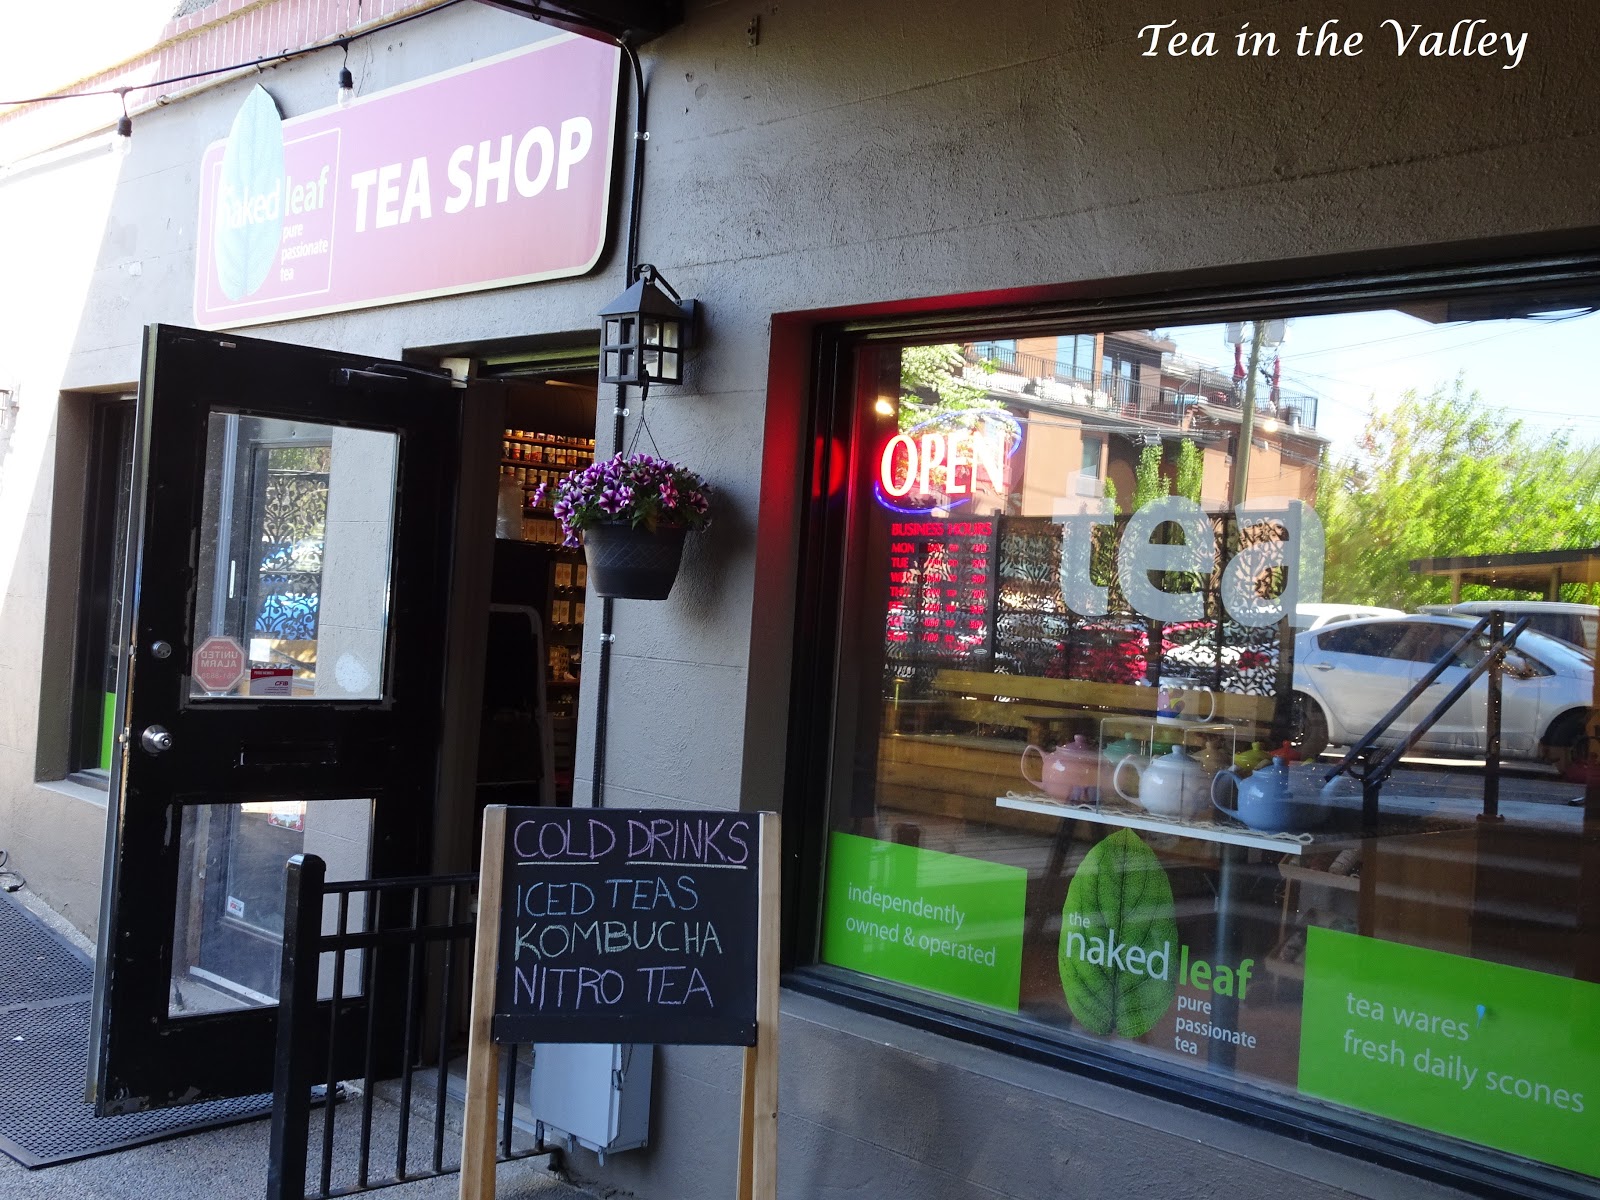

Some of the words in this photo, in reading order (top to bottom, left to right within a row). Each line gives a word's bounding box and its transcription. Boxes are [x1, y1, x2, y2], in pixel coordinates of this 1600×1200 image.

[284, 165, 330, 216] leaf
[351, 156, 432, 233] TEA
[444, 115, 593, 215] SHOP
[280, 238, 329, 265] passionate
[282, 222, 304, 243] pure
[279, 266, 295, 282] tea
[880, 431, 1006, 497] OPEN
[891, 522, 944, 537] BUSINESS
[947, 522, 993, 537] HOURS
[891, 542, 915, 553] MON
[1052, 466, 1326, 628] tea
[891, 557, 909, 568] TUE
[514, 818, 616, 859] COLD
[627, 818, 749, 863] DRINKS
[516, 881, 595, 917] ICED
[605, 875, 698, 910] TEAS
[847, 882, 966, 930] independently
[514, 920, 723, 961] KOMBUCHA
[845, 914, 899, 944] owned
[903, 927, 916, 948] &
[918, 934, 996, 968] operated
[1068, 911, 1090, 929] the
[1065, 928, 1170, 981] naked
[1179, 944, 1254, 1000] leaf
[513, 964, 624, 1010] NITRO
[637, 966, 714, 1007] TEA
[1177, 994, 1212, 1016] pure
[1175, 1014, 1257, 1049] passionate
[1346, 992, 1384, 1022] tea
[1393, 1006, 1470, 1041] wares
[1174, 1035, 1198, 1056] tea
[1343, 1028, 1405, 1068] fresh
[1413, 1048, 1479, 1090] daily
[1485, 1070, 1585, 1113] scones
